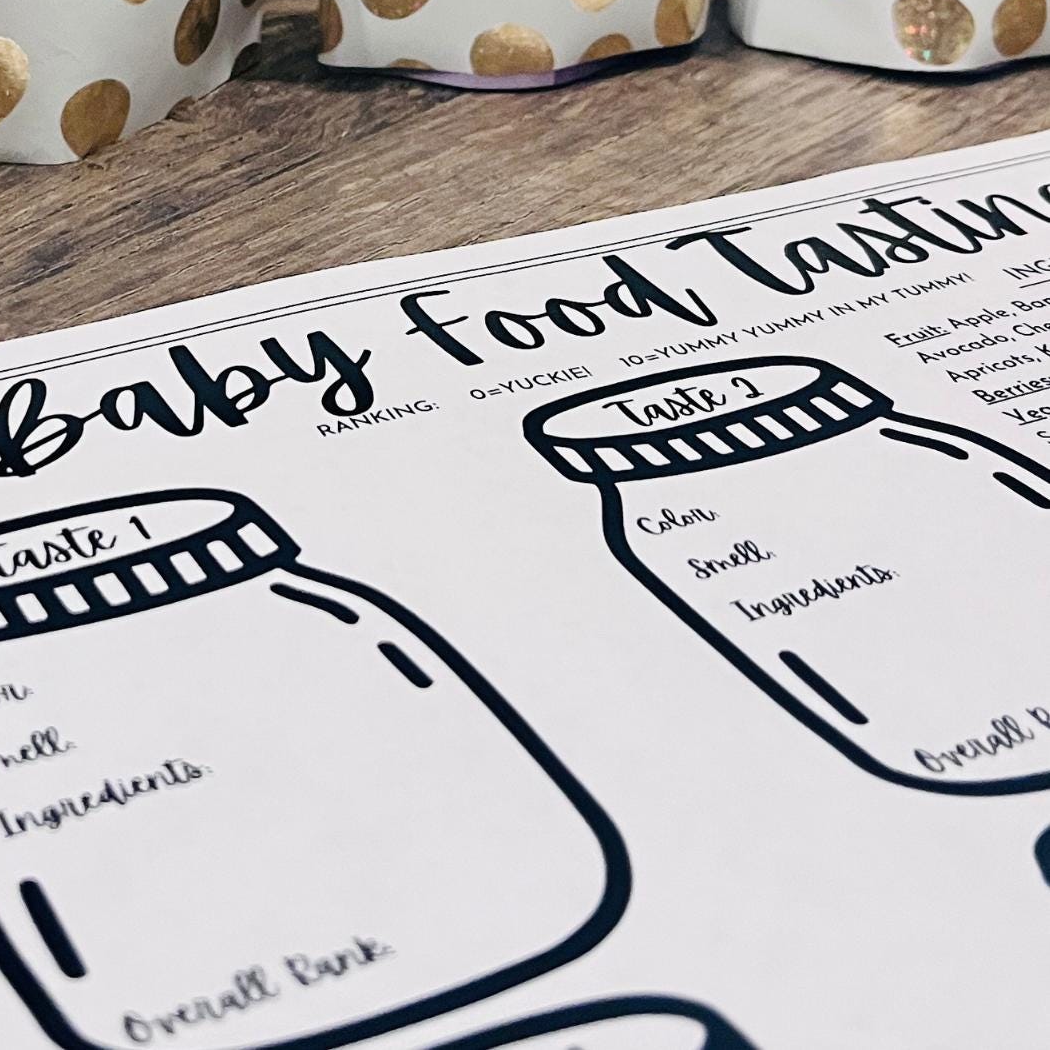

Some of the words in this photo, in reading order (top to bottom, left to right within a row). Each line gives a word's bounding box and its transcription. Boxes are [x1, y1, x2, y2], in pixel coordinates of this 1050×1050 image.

[399, 253, 719, 367] Food
[884, 324, 951, 348] Fruit:
[947, 308, 1017, 329] Apple,
[316, 398, 441, 438] RANKING:
[619, 332, 739, 368] 10=YUMMY
[741, 310, 825, 338] YUMMY
[828, 302, 857, 317] IN
[855, 293, 890, 309] MY
[891, 272, 975, 300] TUMMY!
[916, 333, 1016, 364] Avocado,
[946, 353, 1042, 383] Apricots,
[602, 386, 726, 427] Taste
[731, 376, 765, 400] 2
[128, 515, 152, 540] 1
[913, 714, 1035, 773] Overall
[122, 968, 278, 1043] Overall
